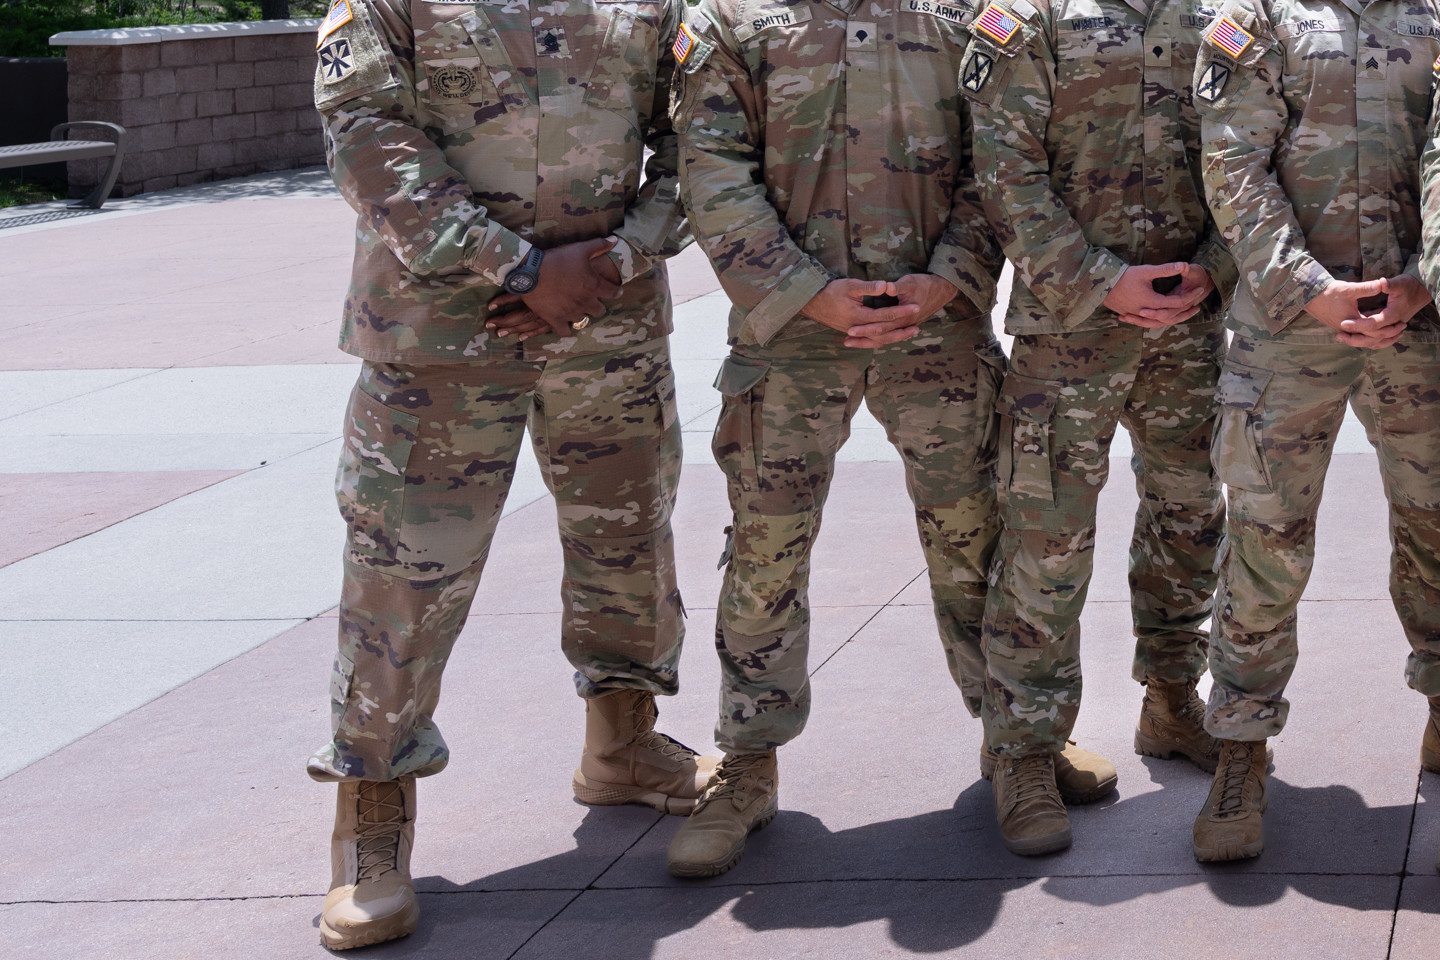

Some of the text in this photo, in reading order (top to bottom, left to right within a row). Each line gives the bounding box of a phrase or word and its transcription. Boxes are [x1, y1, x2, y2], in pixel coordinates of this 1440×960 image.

[909, 0, 966, 23] U.S. ARMY
[753, 13, 791, 31] SMITH
[1295, 19, 1325, 35] JONES
[1409, 25, 1425, 36] U.S.
